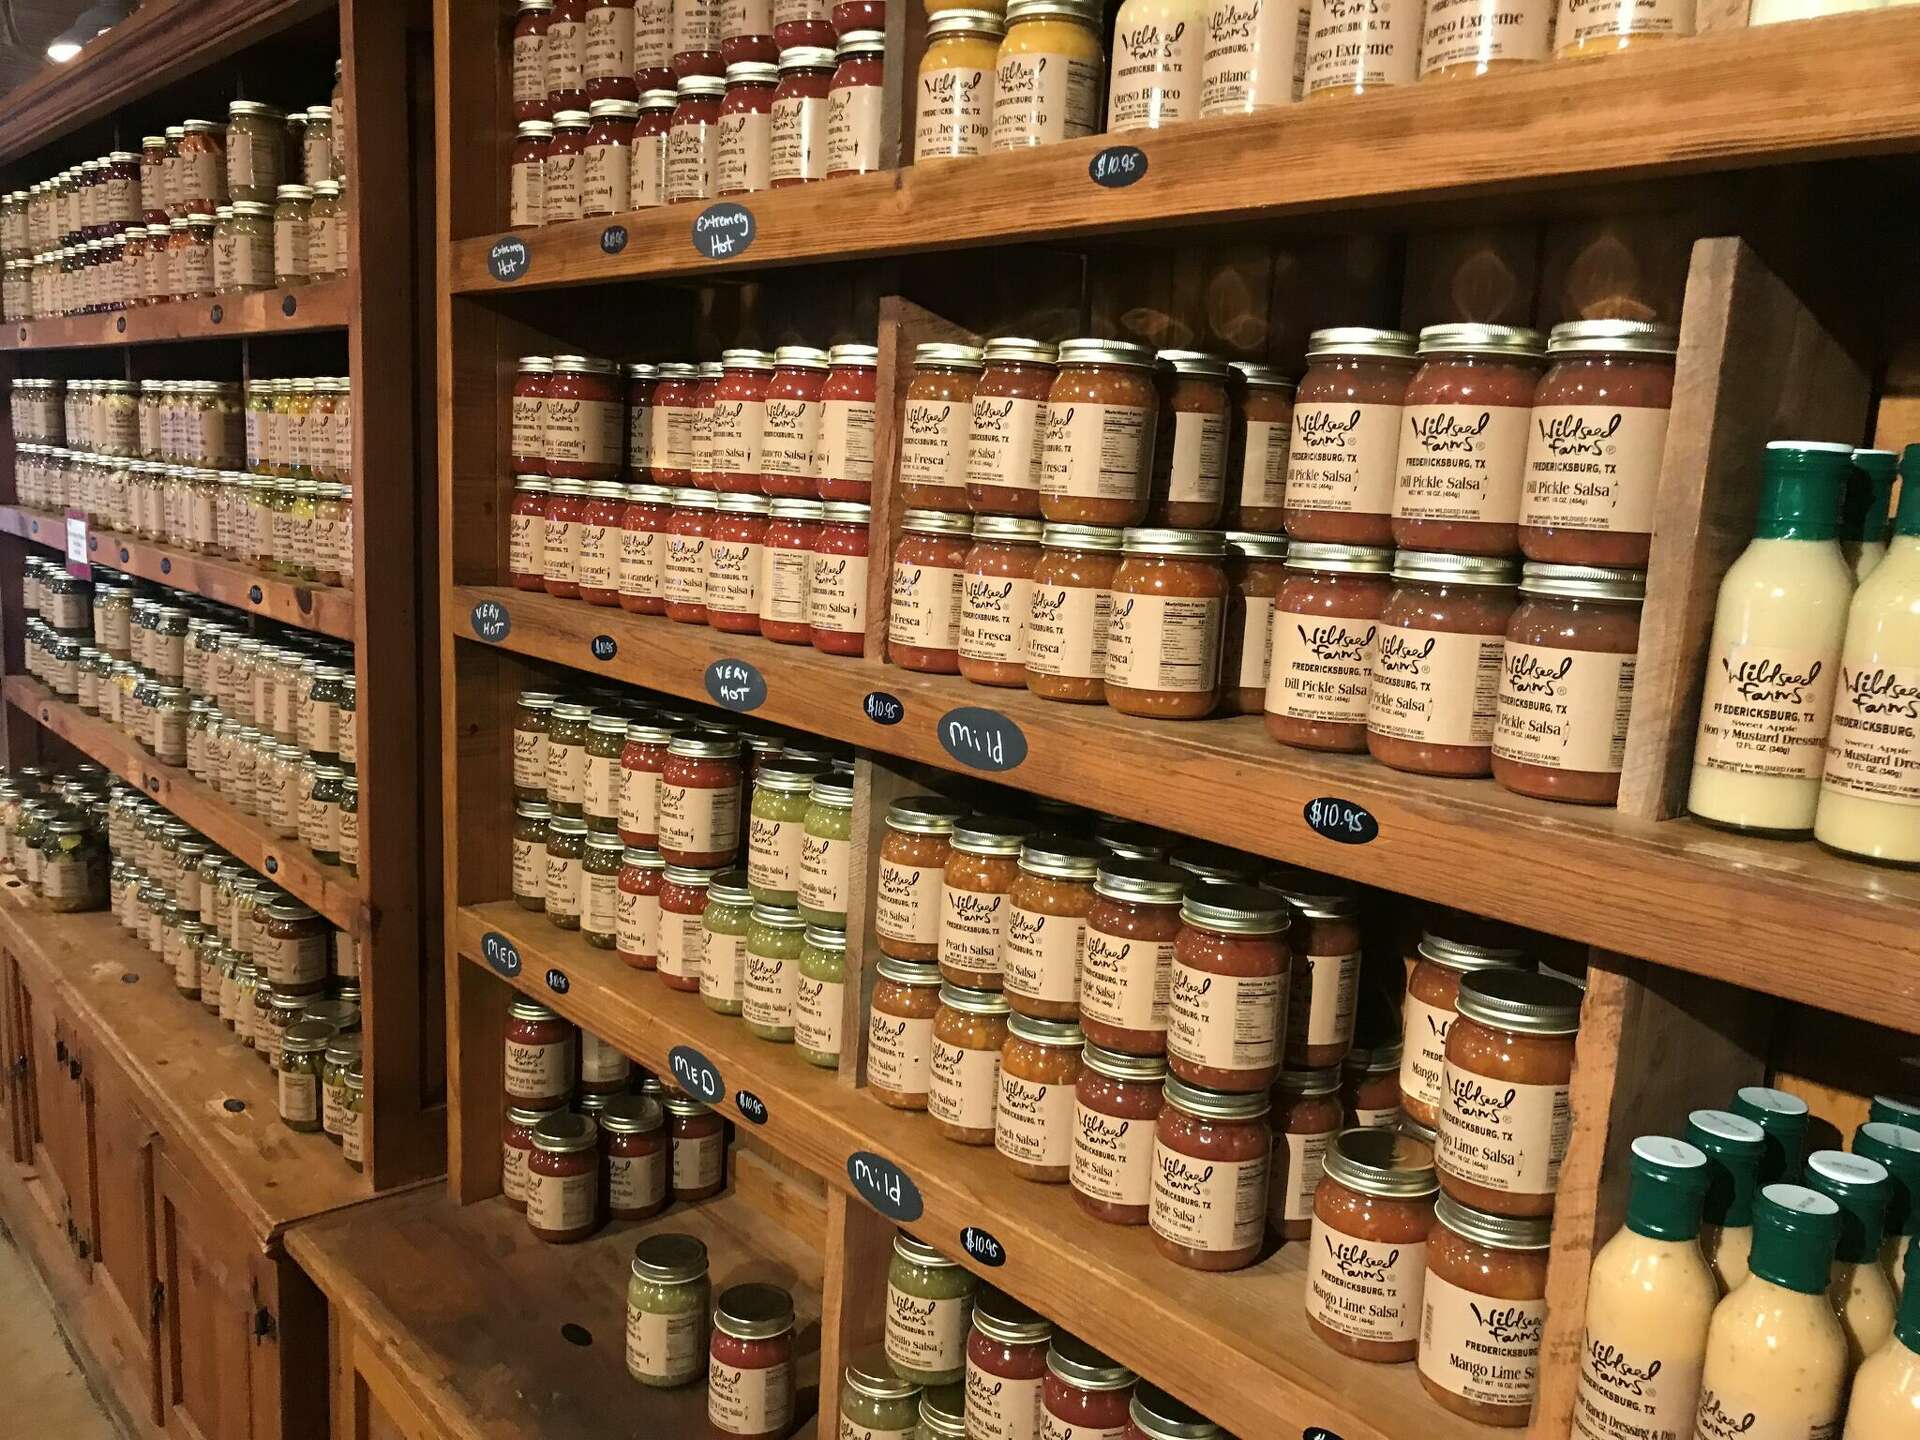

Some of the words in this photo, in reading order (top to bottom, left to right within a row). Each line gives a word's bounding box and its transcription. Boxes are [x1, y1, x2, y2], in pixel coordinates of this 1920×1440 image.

[1121, 22, 1185, 50] Wildsed
[1094, 153, 1138, 180] $10.95
[696, 213, 748, 238] Extremely
[711, 234, 735, 257] Hot
[497, 259, 518, 277] Hot
[1296, 409, 1361, 437] Wildseed
[1411, 411, 1491, 438] Wildseed
[1539, 413, 1622, 440] Wildseed
[784, 449, 807, 461] Salsa
[914, 453, 944, 468] Fresca
[1346, 453, 1358, 464] TX
[1405, 457, 1474, 470] FREDERICKSBURG,
[1475, 459, 1487, 470] TX
[1295, 469, 1321, 483] Pickle
[1321, 469, 1352, 484] Salsa
[1605, 463, 1617, 475] TX
[1412, 475, 1445, 490] Pickle
[1446, 476, 1480, 491] Salsa
[1538, 480, 1571, 496] Pickle
[1573, 482, 1610, 498] Salsa
[476, 601, 501, 622] VERY
[828, 603, 851, 615] Salsa
[483, 621, 504, 637] HOT
[894, 612, 921, 627] Fresca
[1002, 615, 1010, 625] TX
[977, 628, 1012, 644] Fresca
[1296, 624, 1377, 649] Wildseed
[1031, 638, 1060, 655] Fresca
[715, 665, 749, 685] VERY
[1292, 662, 1363, 677] FREDERICKSBURG,
[1722, 658, 1823, 688] Wildseed
[719, 685, 751, 703] HOT
[1284, 676, 1300, 691] Dill
[1301, 678, 1336, 695] Pickle
[1337, 682, 1368, 697] Salsa
[1420, 682, 1432, 693] TX
[868, 693, 899, 720] $10.95
[1395, 697, 1426, 713] Salsa
[1555, 703, 1568, 715] TX
[1502, 712, 1526, 729] Pickle
[1528, 716, 1562, 734] Salsa
[1803, 712, 1815, 723] TX
[949, 721, 1004, 766] Mild
[1703, 723, 1730, 739] Hony
[1731, 728, 1780, 746] Mustard
[1844, 749, 1892, 768] Mustard
[1309, 799, 1367, 833] $10.95
[486, 938, 519, 970] MED
[945, 938, 968, 955] Peach
[969, 943, 995, 957] Salsa
[1014, 965, 1037, 981] Salsa
[1094, 984, 1117, 1002] Salsa
[673, 1054, 715, 1096] MED
[1411, 1062, 1440, 1085] Mango
[1446, 1070, 1517, 1112] Wildseed
[739, 1090, 764, 1117] $10.95
[1441, 1110, 1500, 1142] FREDERICKSBURG,
[1501, 1132, 1514, 1144] TX
[1015, 1133, 1040, 1150] Salsa
[1454, 1135, 1480, 1158] Lime
[1482, 1145, 1515, 1166] Salsa
[1091, 1162, 1114, 1180] Salsa
[1157, 1148, 1214, 1183] Wildseed
[855, 1158, 901, 1207] Mild
[1202, 1201, 1212, 1211] TX
[1171, 1207, 1196, 1226] Salsa
[966, 1227, 999, 1258] $10.95
[1324, 1234, 1400, 1270] Wildseed
[1320, 1269, 1386, 1298] FREDERICKSBURG,
[1386, 1288, 1398, 1298] TX
[1312, 1280, 1338, 1308] Mango
[1338, 1296, 1367, 1315] Lime
[1367, 1305, 1400, 1320] Salsa
[912, 1340, 941, 1355] Salsa
[1449, 1352, 1489, 1380] Mango
[1490, 1362, 1522, 1381] Lime
[1643, 1404, 1657, 1417] TX
[1608, 1411, 1651, 1440] Dressing
